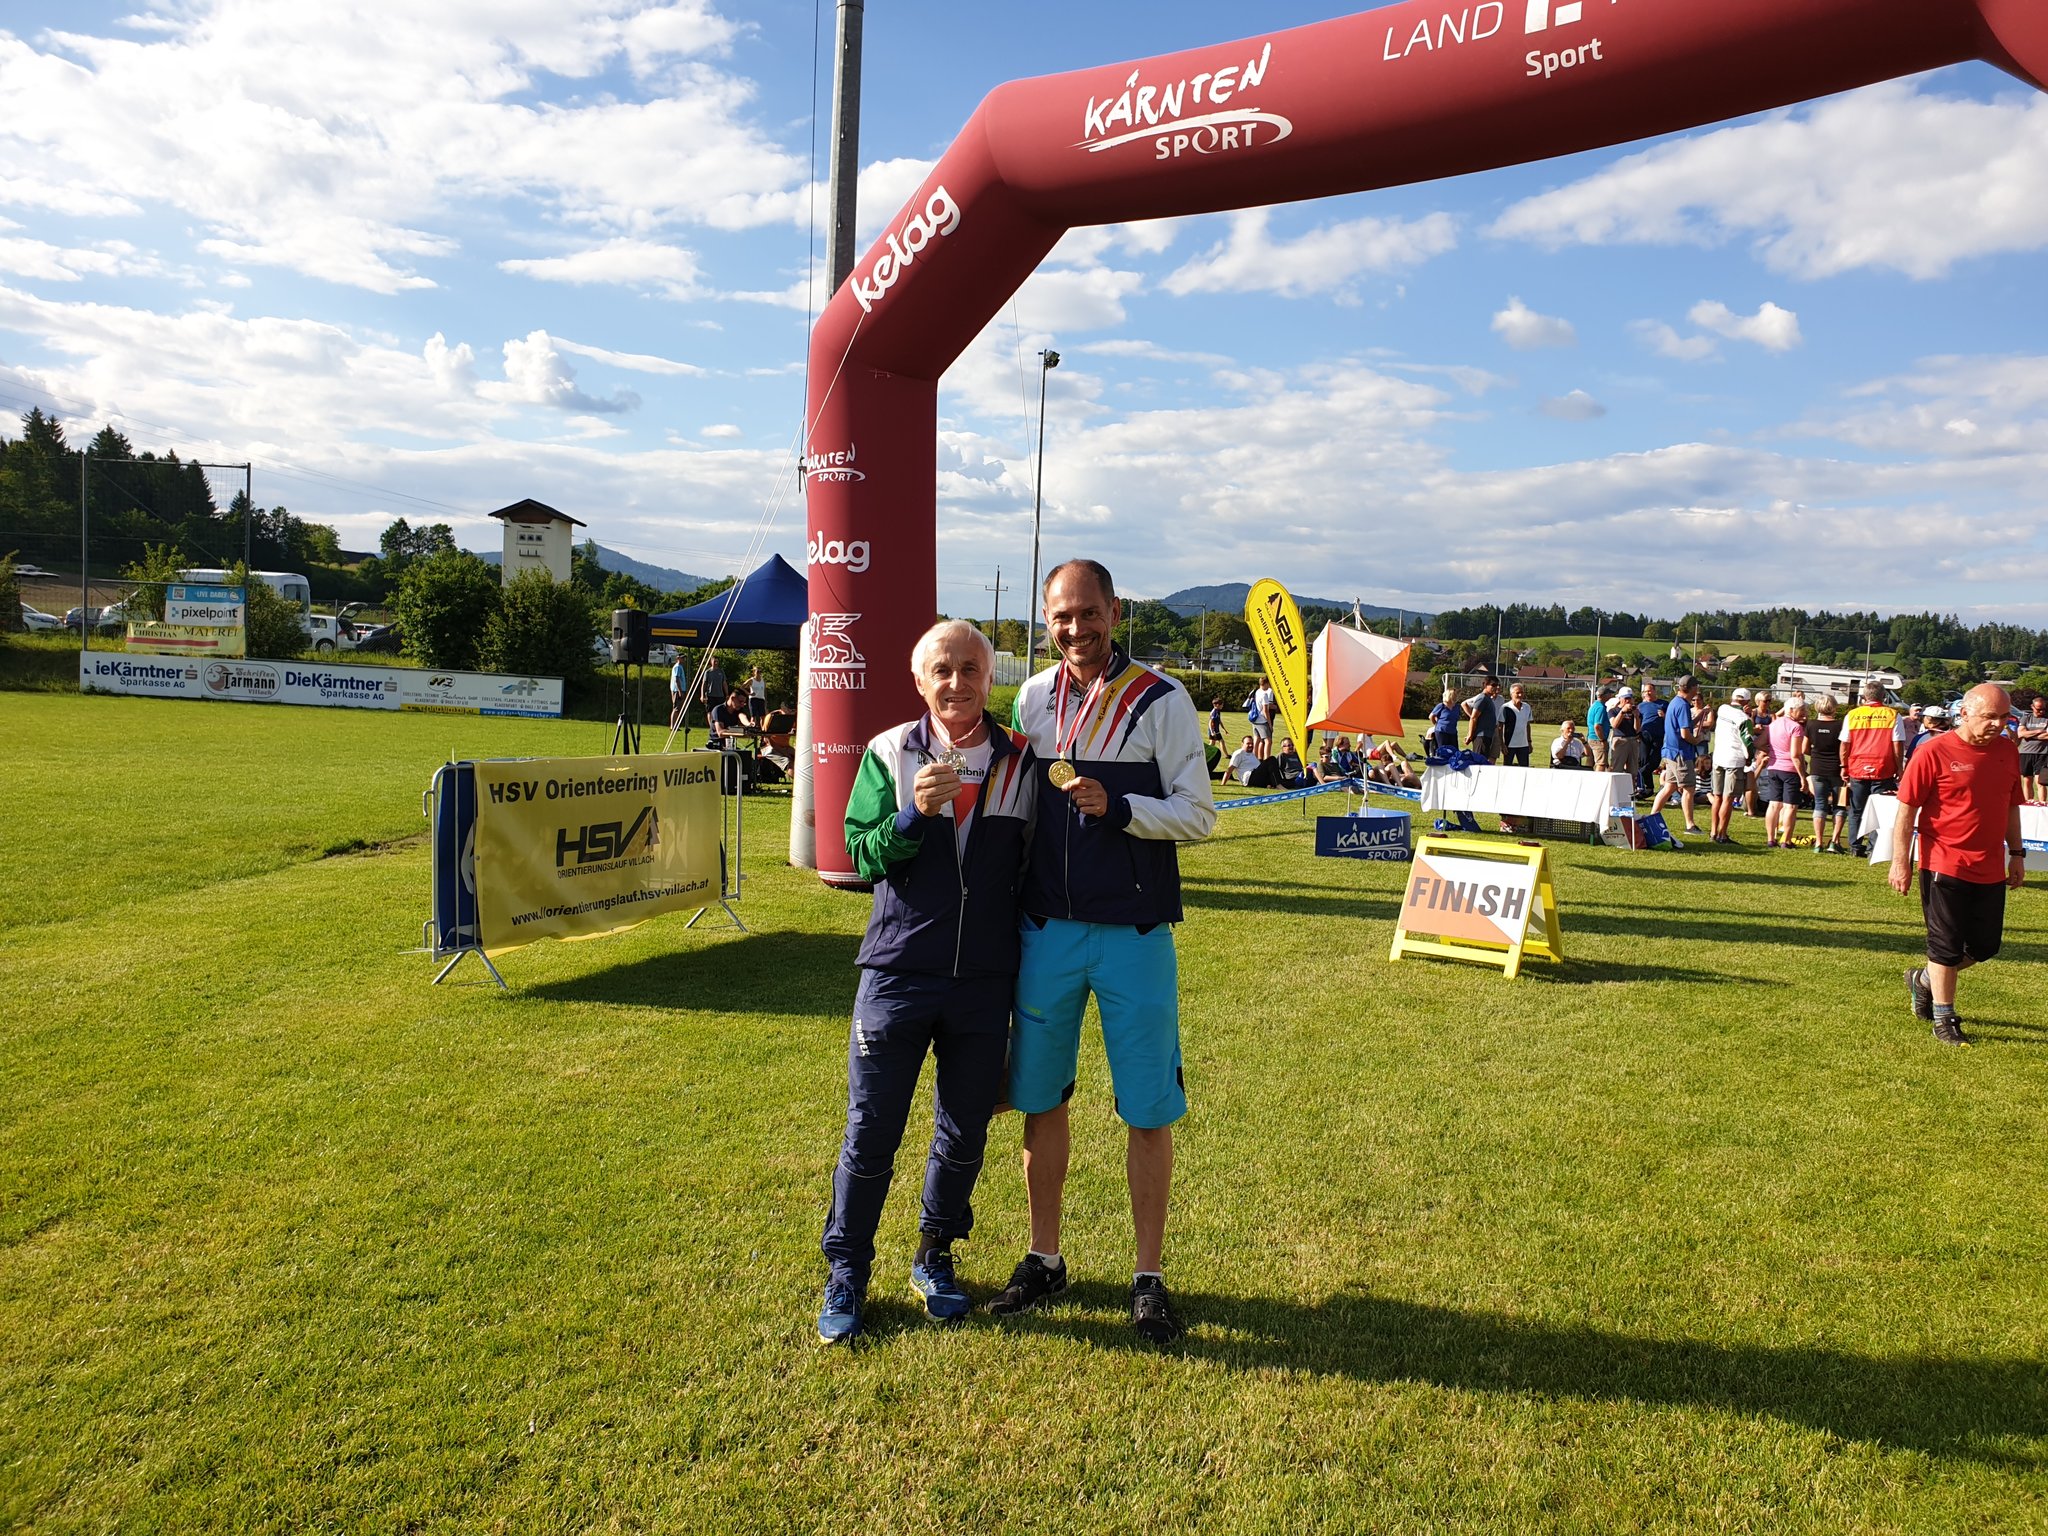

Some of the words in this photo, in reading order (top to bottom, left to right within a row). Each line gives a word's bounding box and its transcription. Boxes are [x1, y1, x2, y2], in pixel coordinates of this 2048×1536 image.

[1383, 1, 1503, 60] LAND
[1525, 38, 1603, 78] Sport
[1155, 122, 1258, 160] SPORT
[850, 185, 961, 313] kelag
[818, 472, 852, 482] SPORT
[807, 530, 870, 573] elag
[181, 606, 238, 620] pixelpoint
[133, 629, 178, 638] CHRISTIAN
[83, 660, 183, 680] ieKärntner
[222, 672, 276, 690] Tarmann
[285, 671, 383, 691] DieKärntner
[119, 676, 171, 688] Sparkasse
[173, 681, 186, 689] AG
[320, 688, 370, 700] Sparkasse
[373, 693, 385, 701] AG
[488, 781, 539, 804] HSV
[545, 773, 658, 800] Orienteering
[663, 766, 716, 788] Villach
[556, 806, 653, 867] HSV
[1367, 849, 1403, 861] SPORT
[557, 858, 628, 879] ORIENTIERUNGSLAUF
[628, 855, 655, 868] VILLACH
[1409, 876, 1526, 920] FINISH
